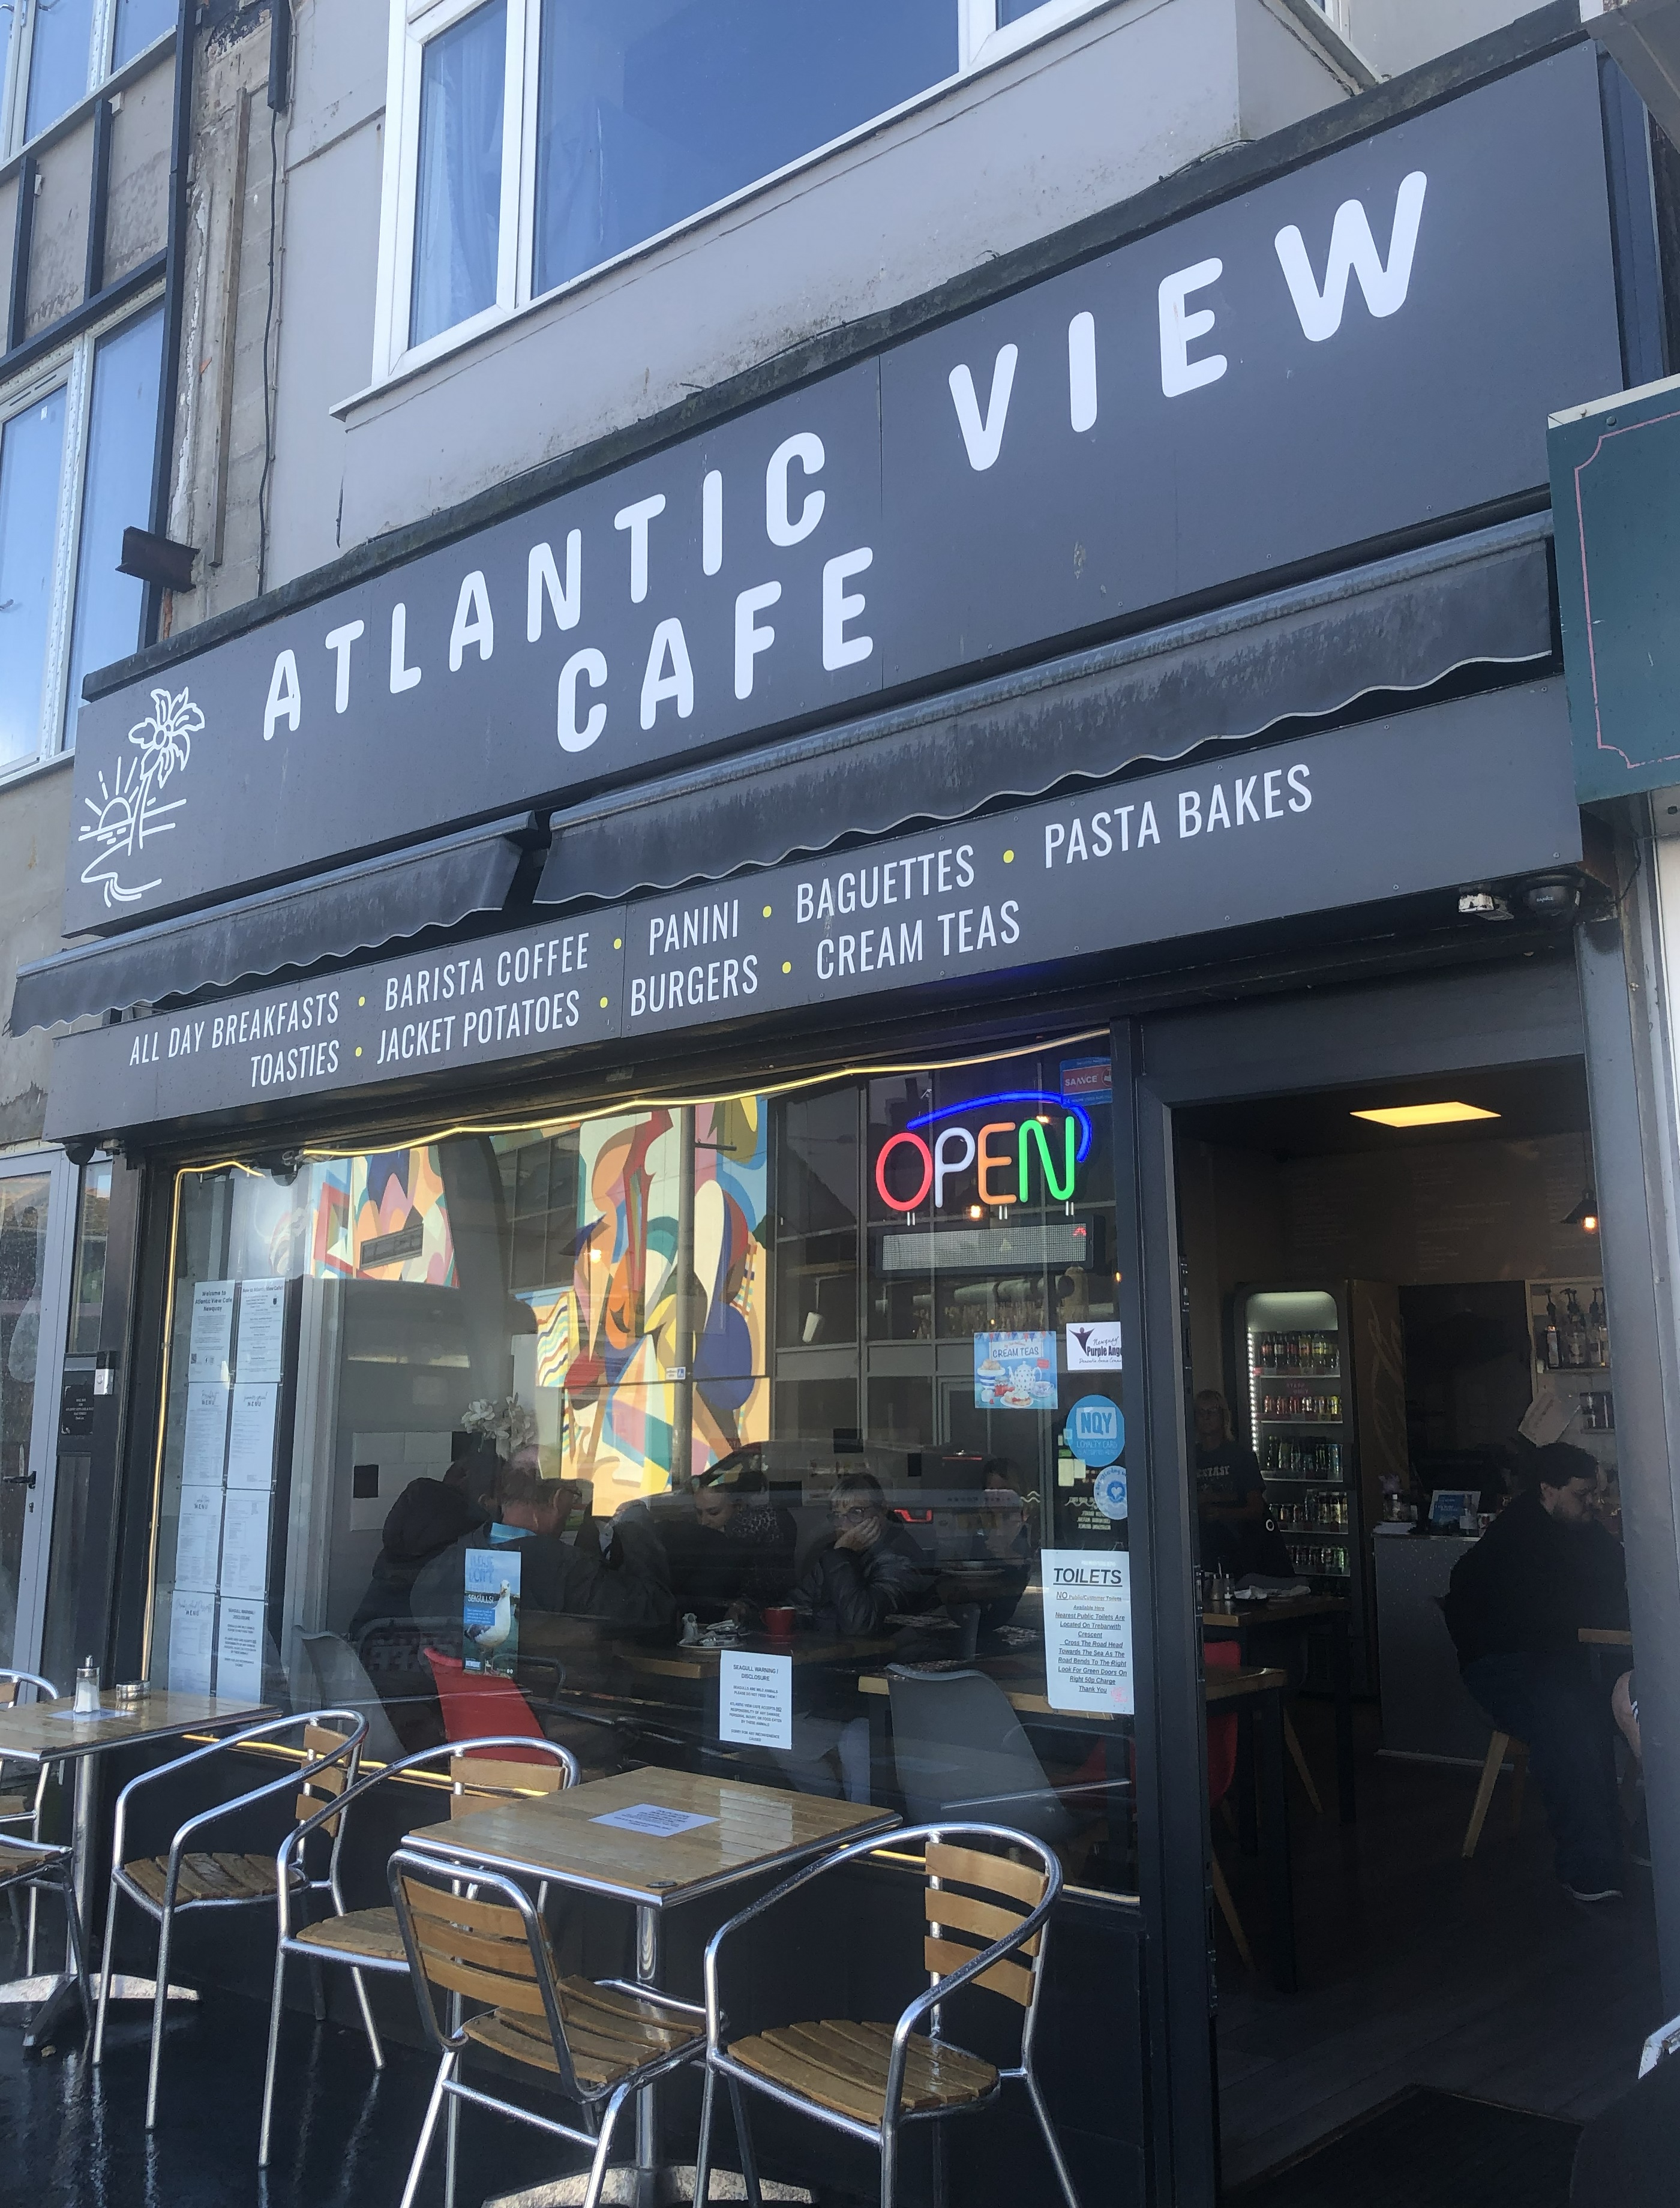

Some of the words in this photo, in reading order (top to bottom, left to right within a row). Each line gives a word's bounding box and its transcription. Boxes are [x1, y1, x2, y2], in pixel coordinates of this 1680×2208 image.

[264, 433, 825, 740] ATLANTIC
[949, 172, 1427, 470] VIEW
[557, 548, 872, 752] CAFE
[130, 1032, 159, 1066] ALL
[168, 1021, 205, 1058] DAY
[212, 991, 339, 1048] BREAKFASTS
[385, 958, 484, 1011] BARISTA
[497, 932, 589, 986] COFFEE
[650, 899, 738, 955] PANINI
[797, 845, 974, 923] BAGUETTES
[1046, 801, 1160, 868] PASTA
[1179, 764, 1312, 838] BAKES
[251, 1040, 339, 1087] TOASTIES
[377, 1015, 455, 1064] JACKET
[463, 990, 579, 1047] POTATOES
[631, 955, 757, 1016] BURGERS
[817, 920, 922, 979] CREAM
[938, 901, 1019, 956] TEAS
[876, 1117, 1074, 1211] OPEN
[993, 1348, 1018, 1358] CREAM
[1020, 1346, 1039, 1355] TEAS
[1087, 1346, 1107, 1357] Purple
[1093, 1336, 1119, 1346] Newquay
[1081, 1412, 1112, 1435] NQY
[1054, 1568, 1121, 1585] TOILETS
[468, 1594, 493, 1604] SEAGULLS!
